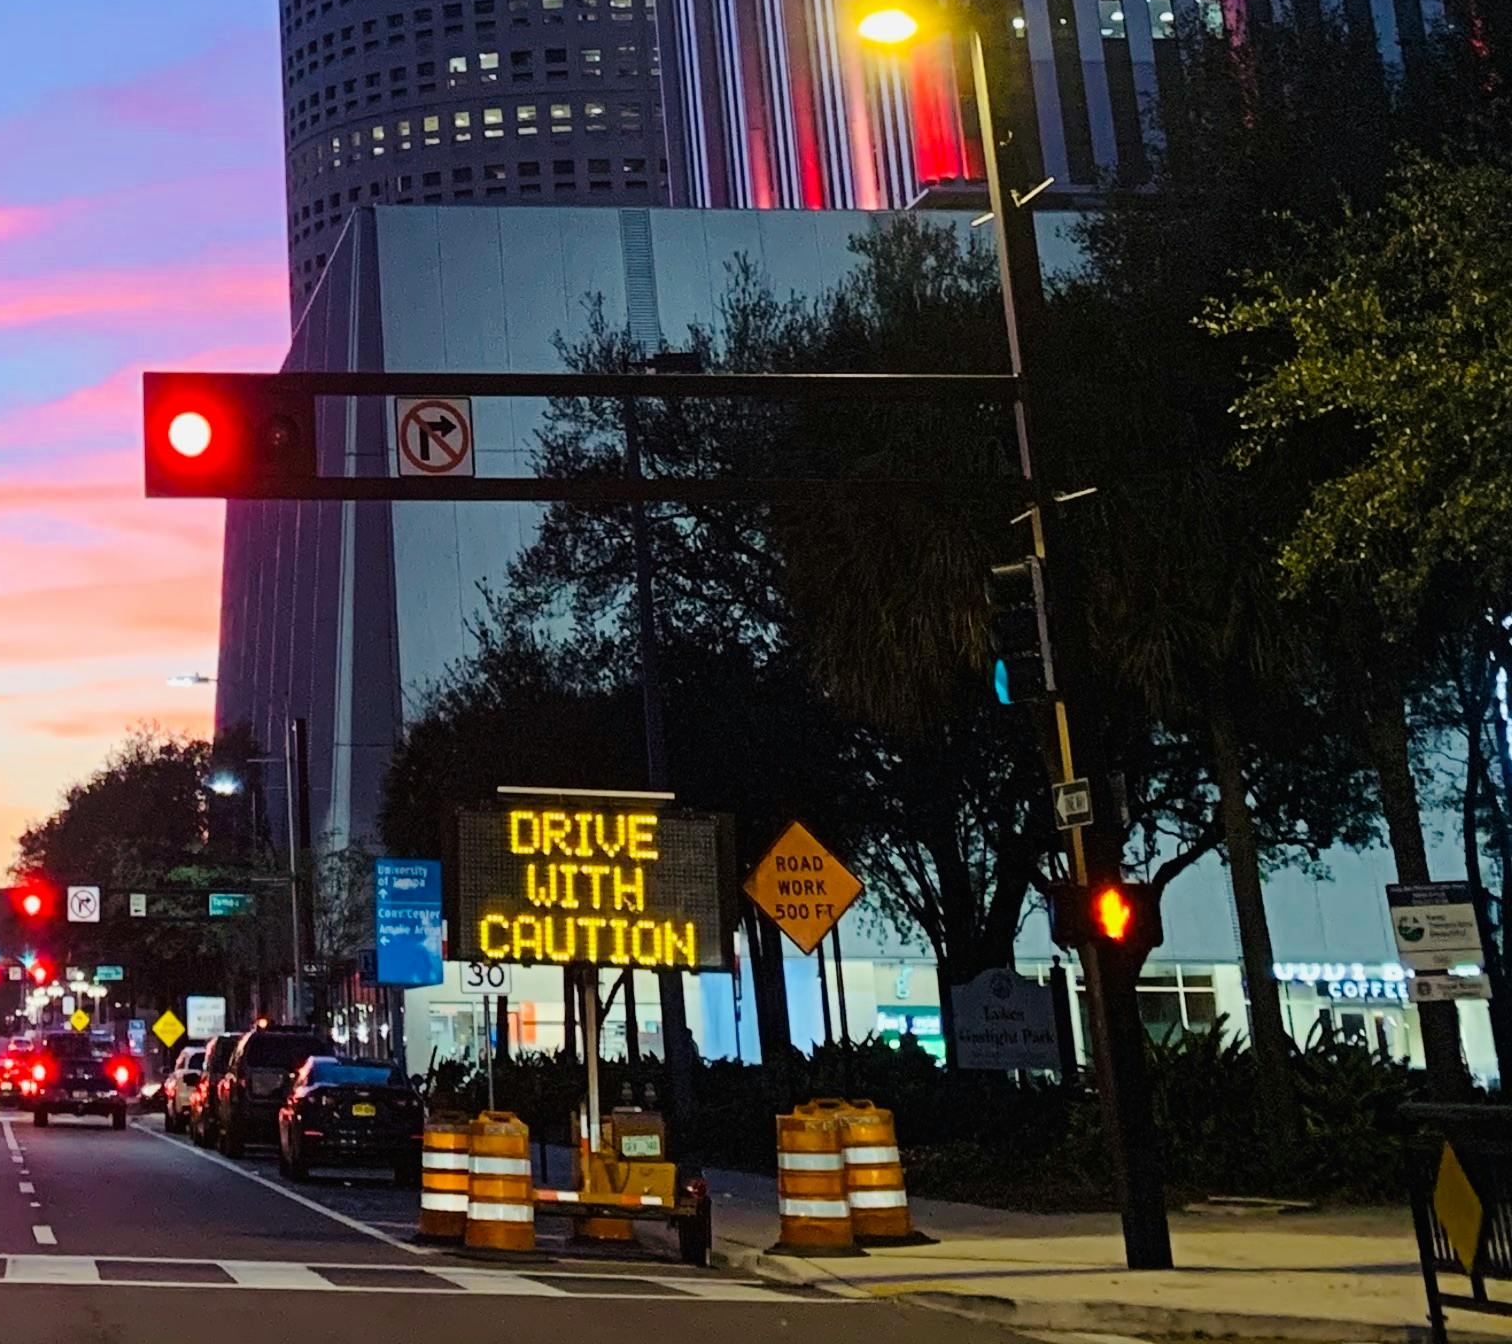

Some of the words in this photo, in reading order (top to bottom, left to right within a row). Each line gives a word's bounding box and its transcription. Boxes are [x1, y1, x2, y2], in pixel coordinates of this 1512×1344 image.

[510, 810, 659, 860] DRIVE
[775, 855, 823, 872] ROAD
[527, 863, 644, 911] WITH
[777, 879, 827, 896] WORK
[774, 903, 810, 920] 500
[815, 904, 836, 920] FT
[480, 914, 695, 967] CAUTION
[467, 963, 504, 987] 30
[1327, 979, 1410, 998] COFFEE
